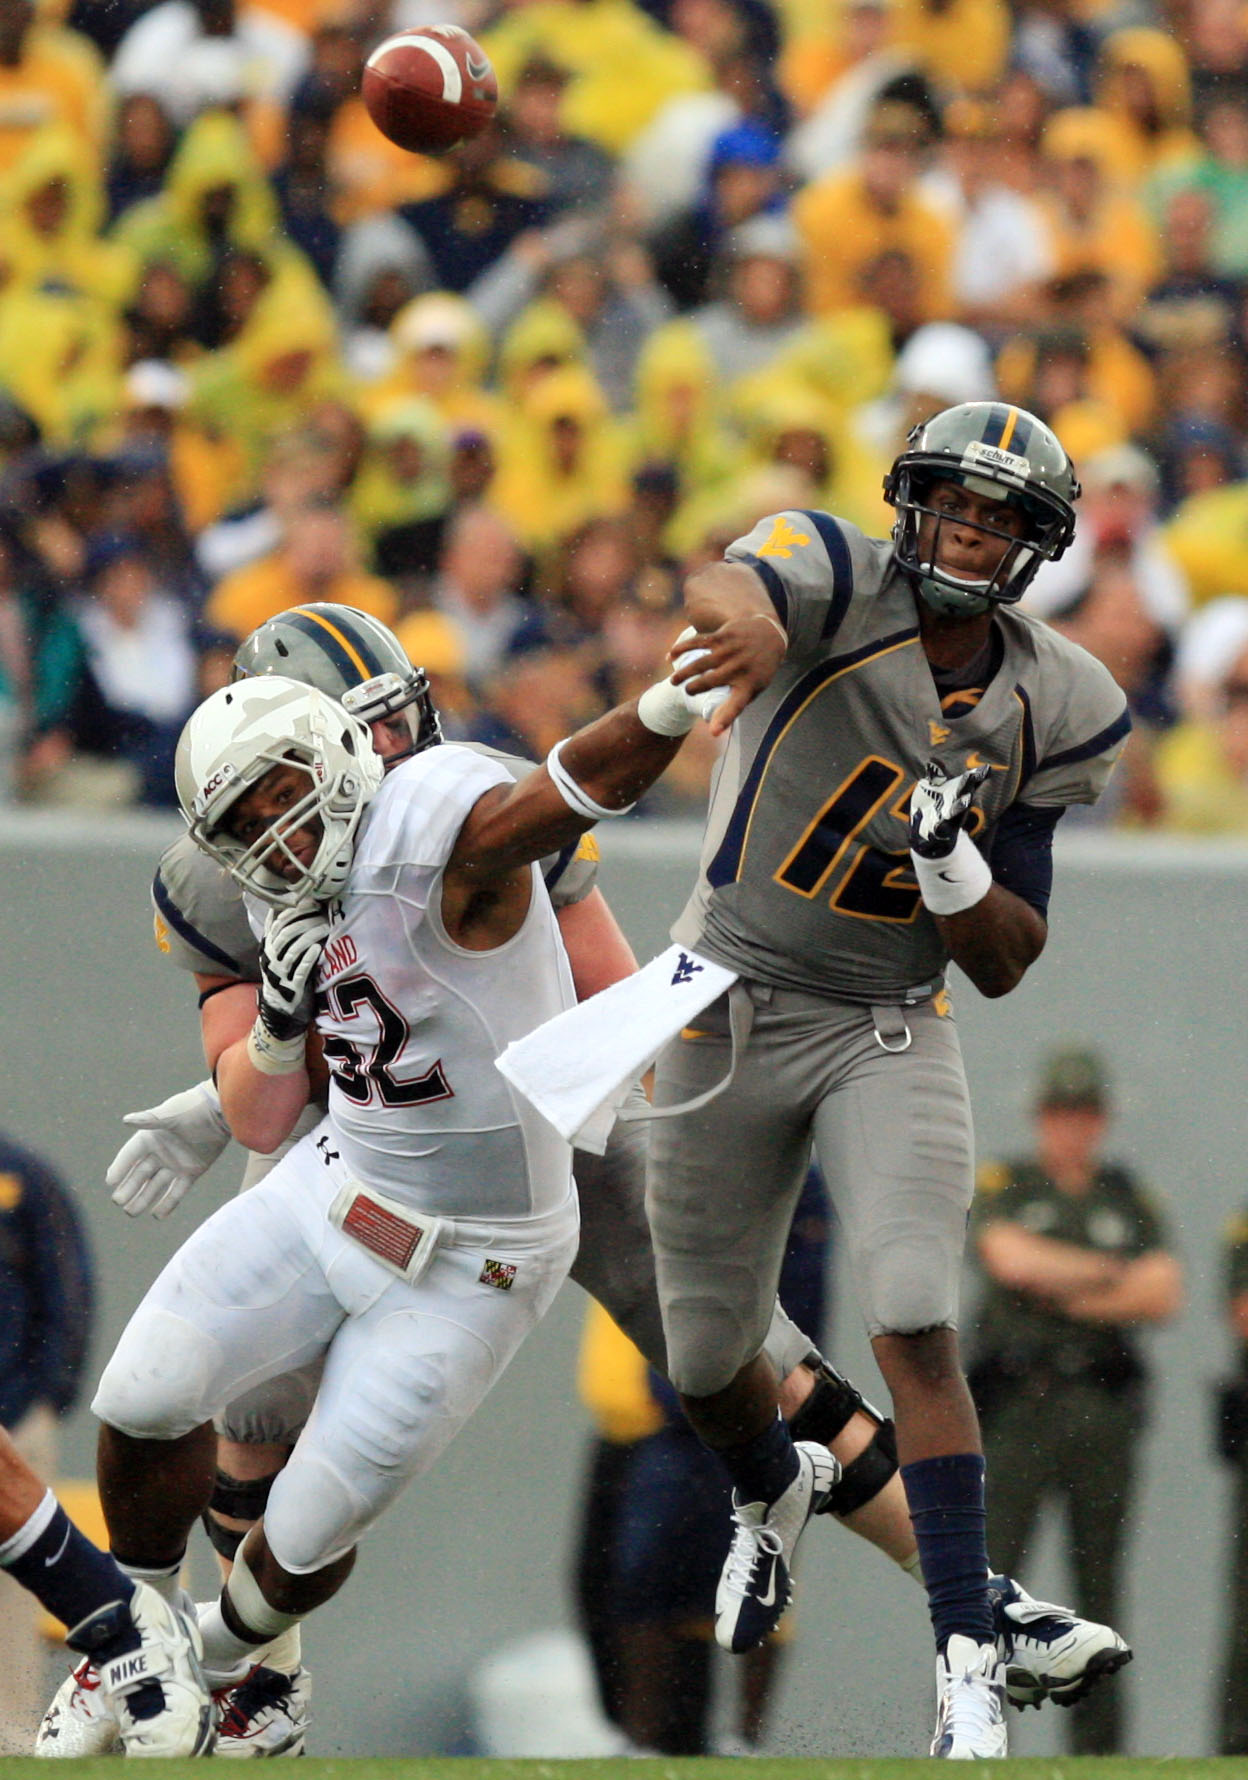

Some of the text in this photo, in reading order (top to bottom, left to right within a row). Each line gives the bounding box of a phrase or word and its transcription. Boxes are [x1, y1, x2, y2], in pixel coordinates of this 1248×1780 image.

[203, 773, 223, 801] ACC
[773, 754, 986, 924] 12
[315, 934, 358, 980] LAND
[318, 972, 456, 1109] 52
[110, 1653, 149, 1686] NIKE
